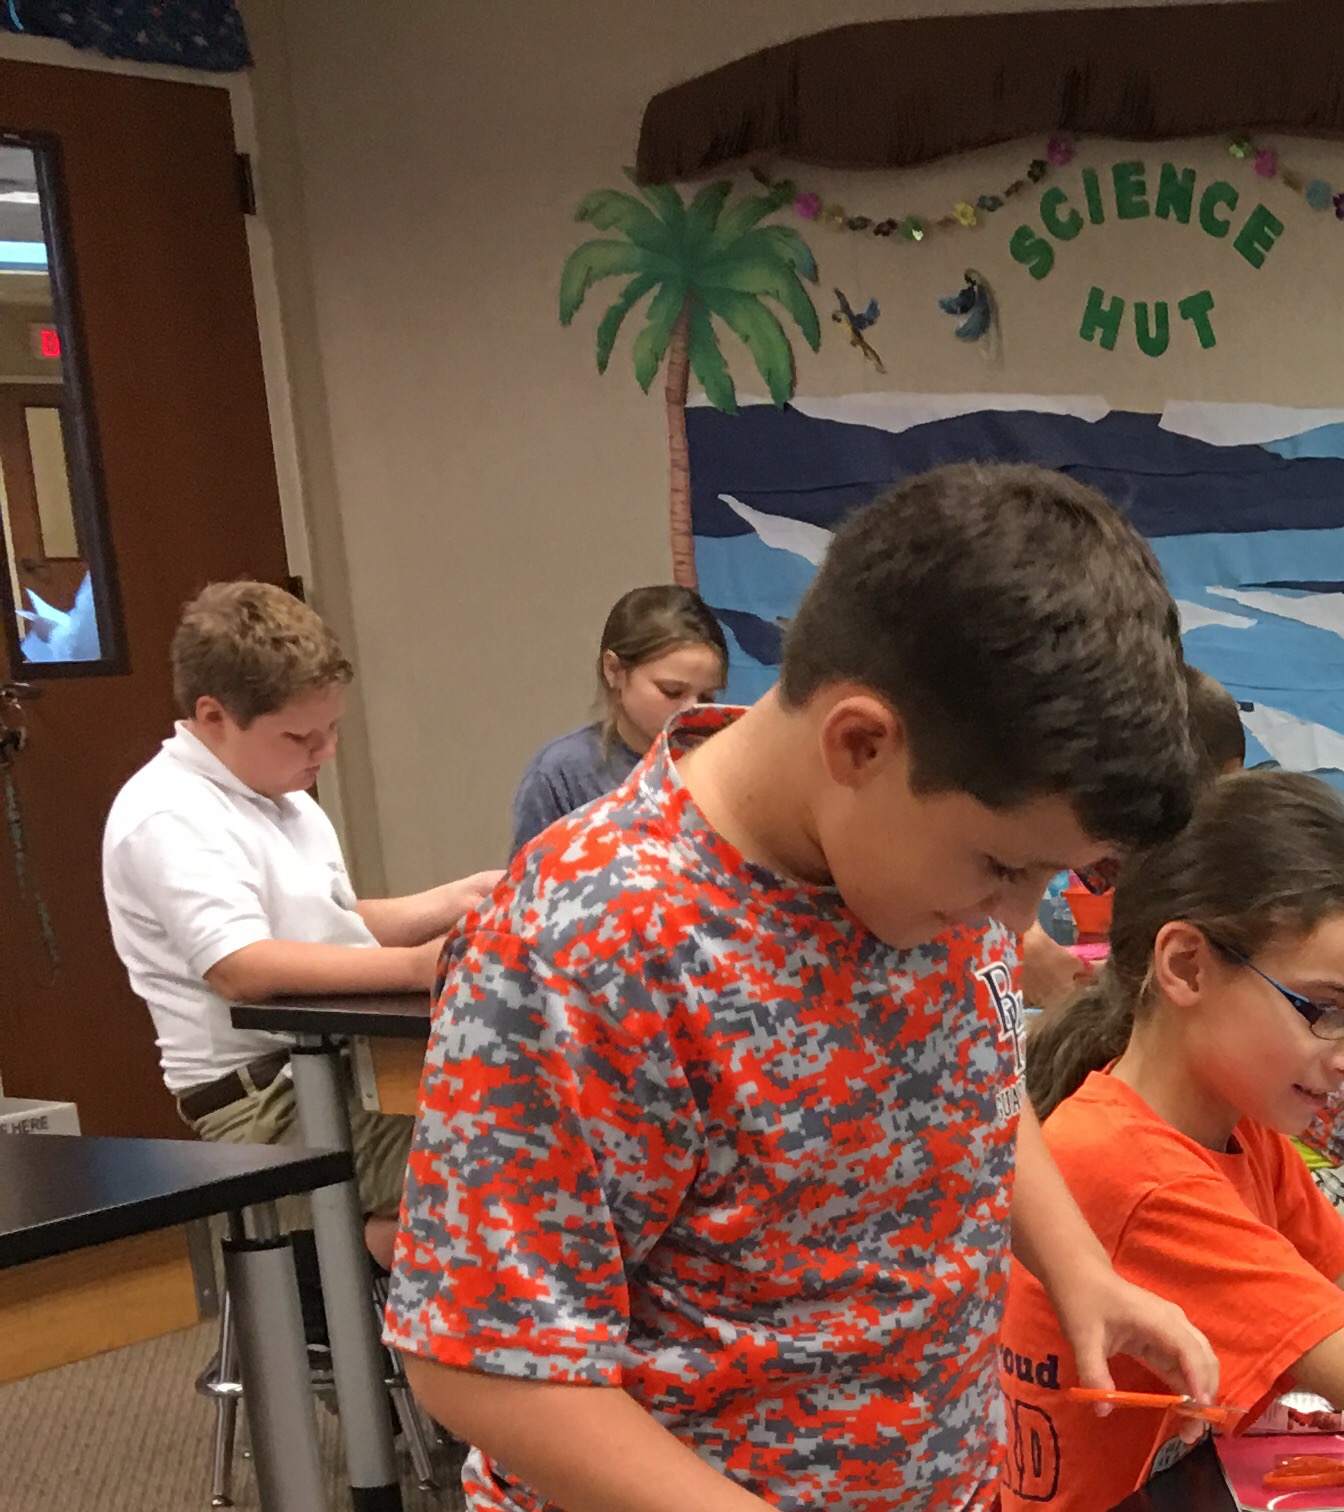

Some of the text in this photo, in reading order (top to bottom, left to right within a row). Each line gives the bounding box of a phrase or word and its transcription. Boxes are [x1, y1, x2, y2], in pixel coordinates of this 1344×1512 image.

[1009, 160, 1285, 280] SCIENCE
[1079, 285, 1217, 358] HUT
[1000, 1344, 1060, 1390] oud
